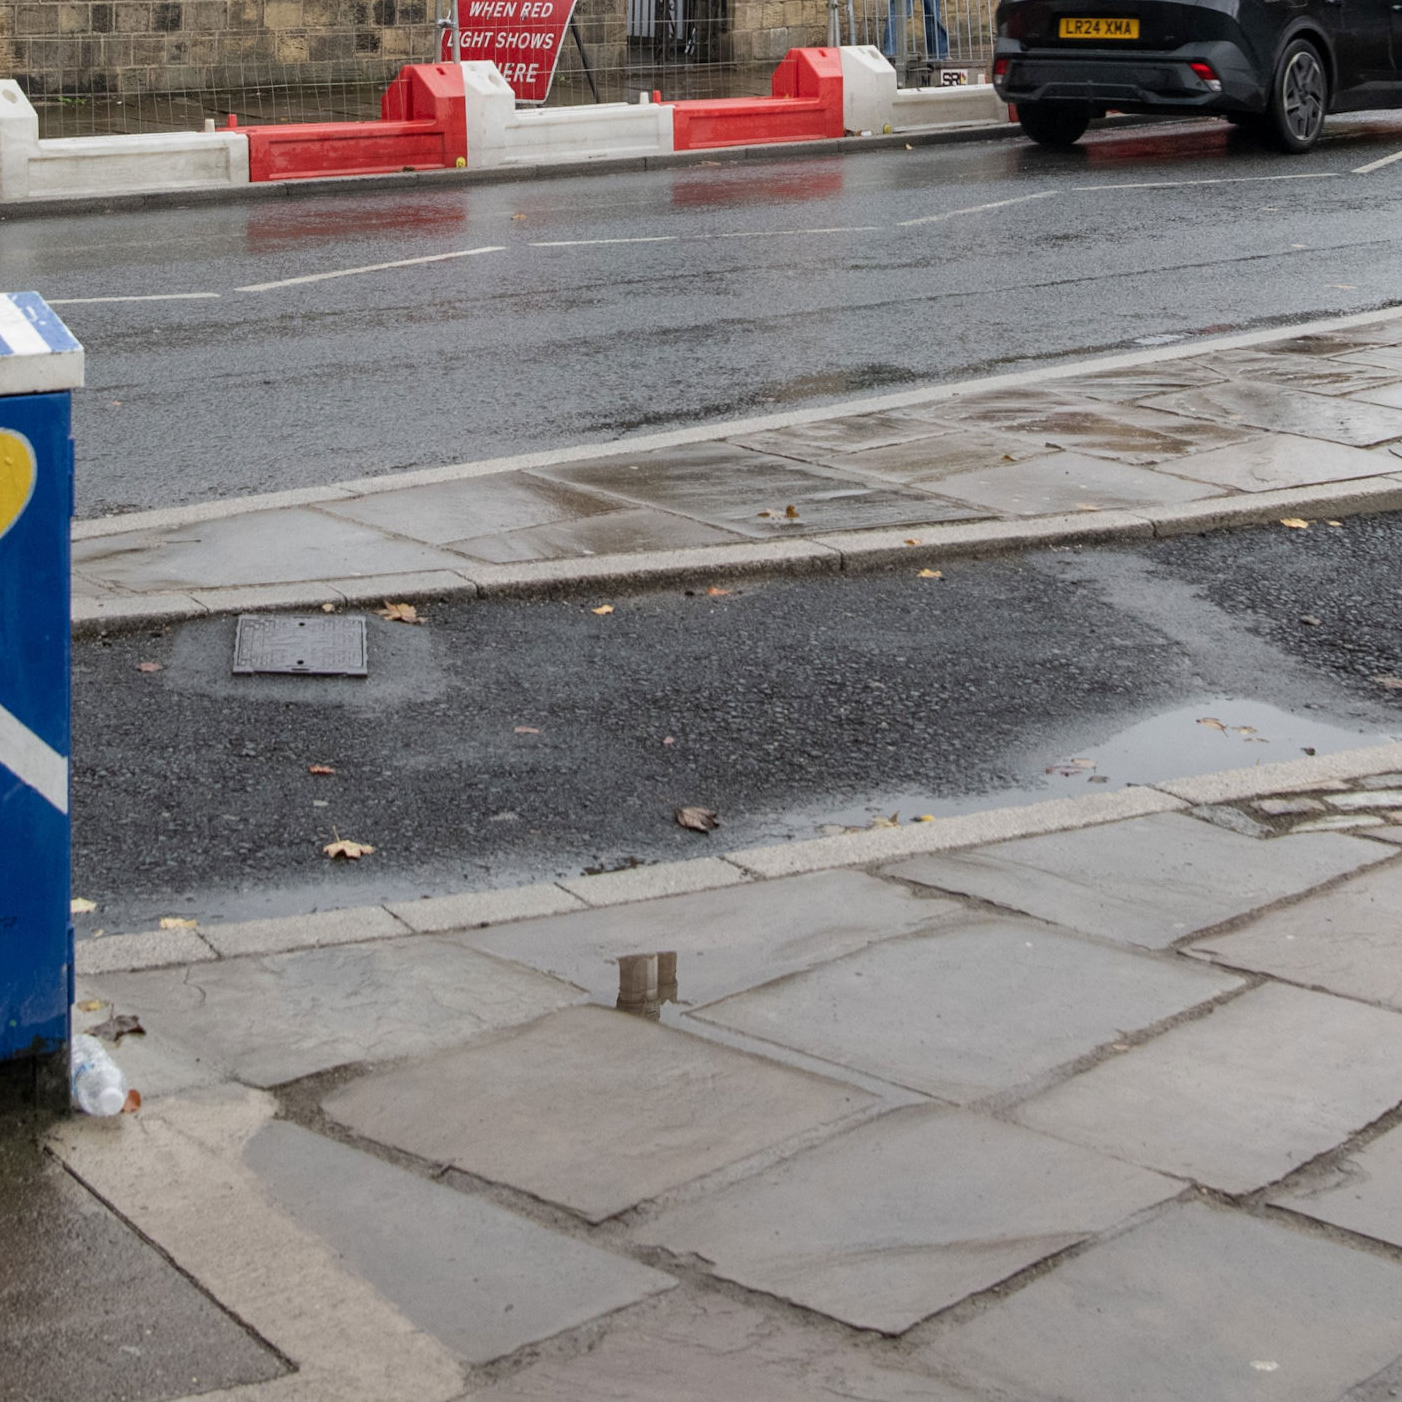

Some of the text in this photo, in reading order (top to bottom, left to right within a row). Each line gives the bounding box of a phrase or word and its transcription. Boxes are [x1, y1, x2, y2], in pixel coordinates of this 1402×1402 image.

[469, 1, 554, 17] WHEN RED
[1065, 19, 1131, 35] LR24 XMA
[495, 32, 555, 49] SHOWS
